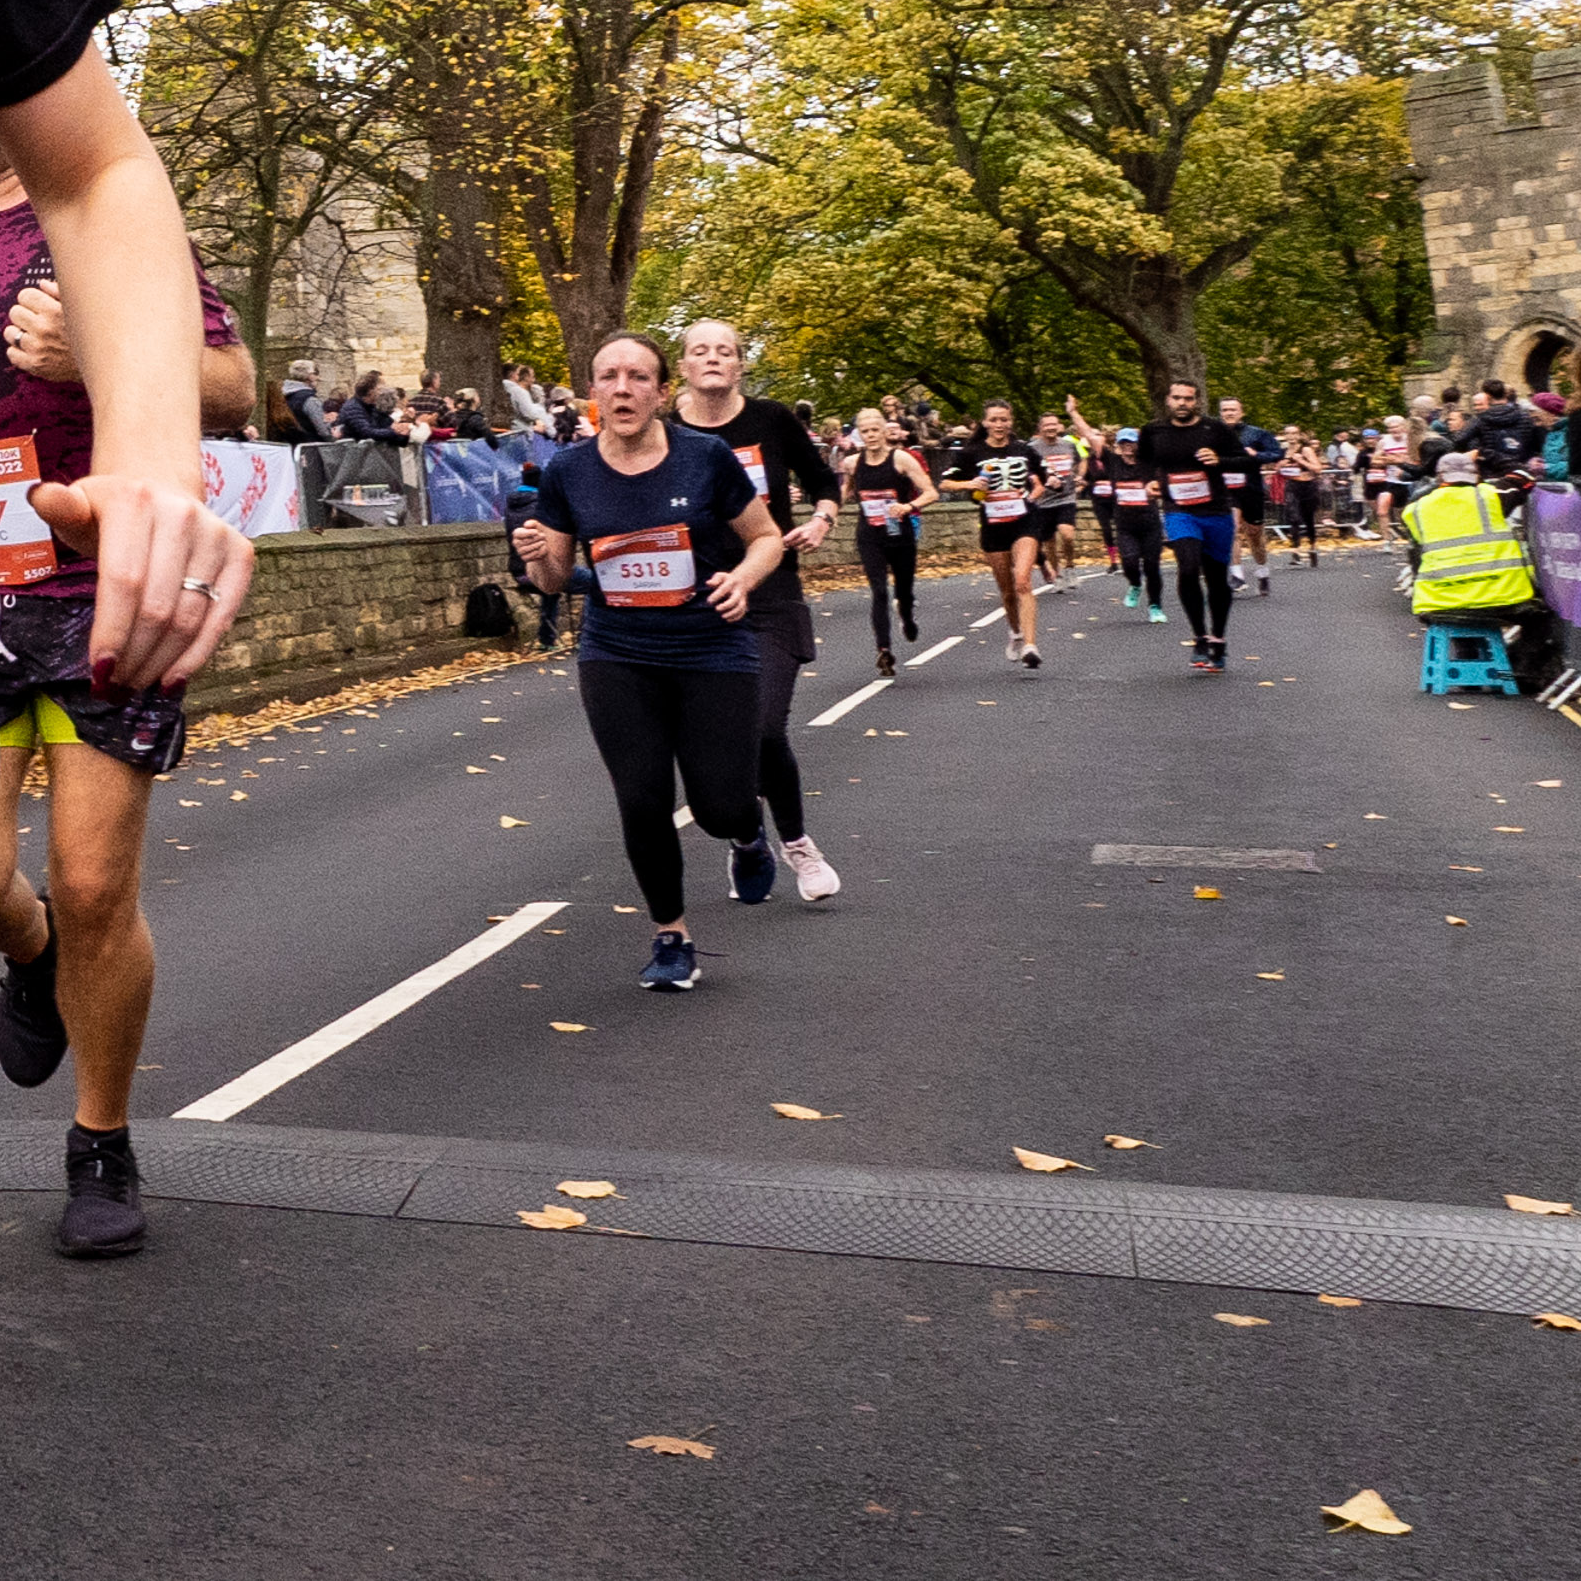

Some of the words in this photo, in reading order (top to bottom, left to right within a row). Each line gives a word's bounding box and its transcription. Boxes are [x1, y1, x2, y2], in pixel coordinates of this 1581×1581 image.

[0, 531, 8, 542] C
[24, 566, 52, 580] 5507
[620, 561, 670, 578] 5318
